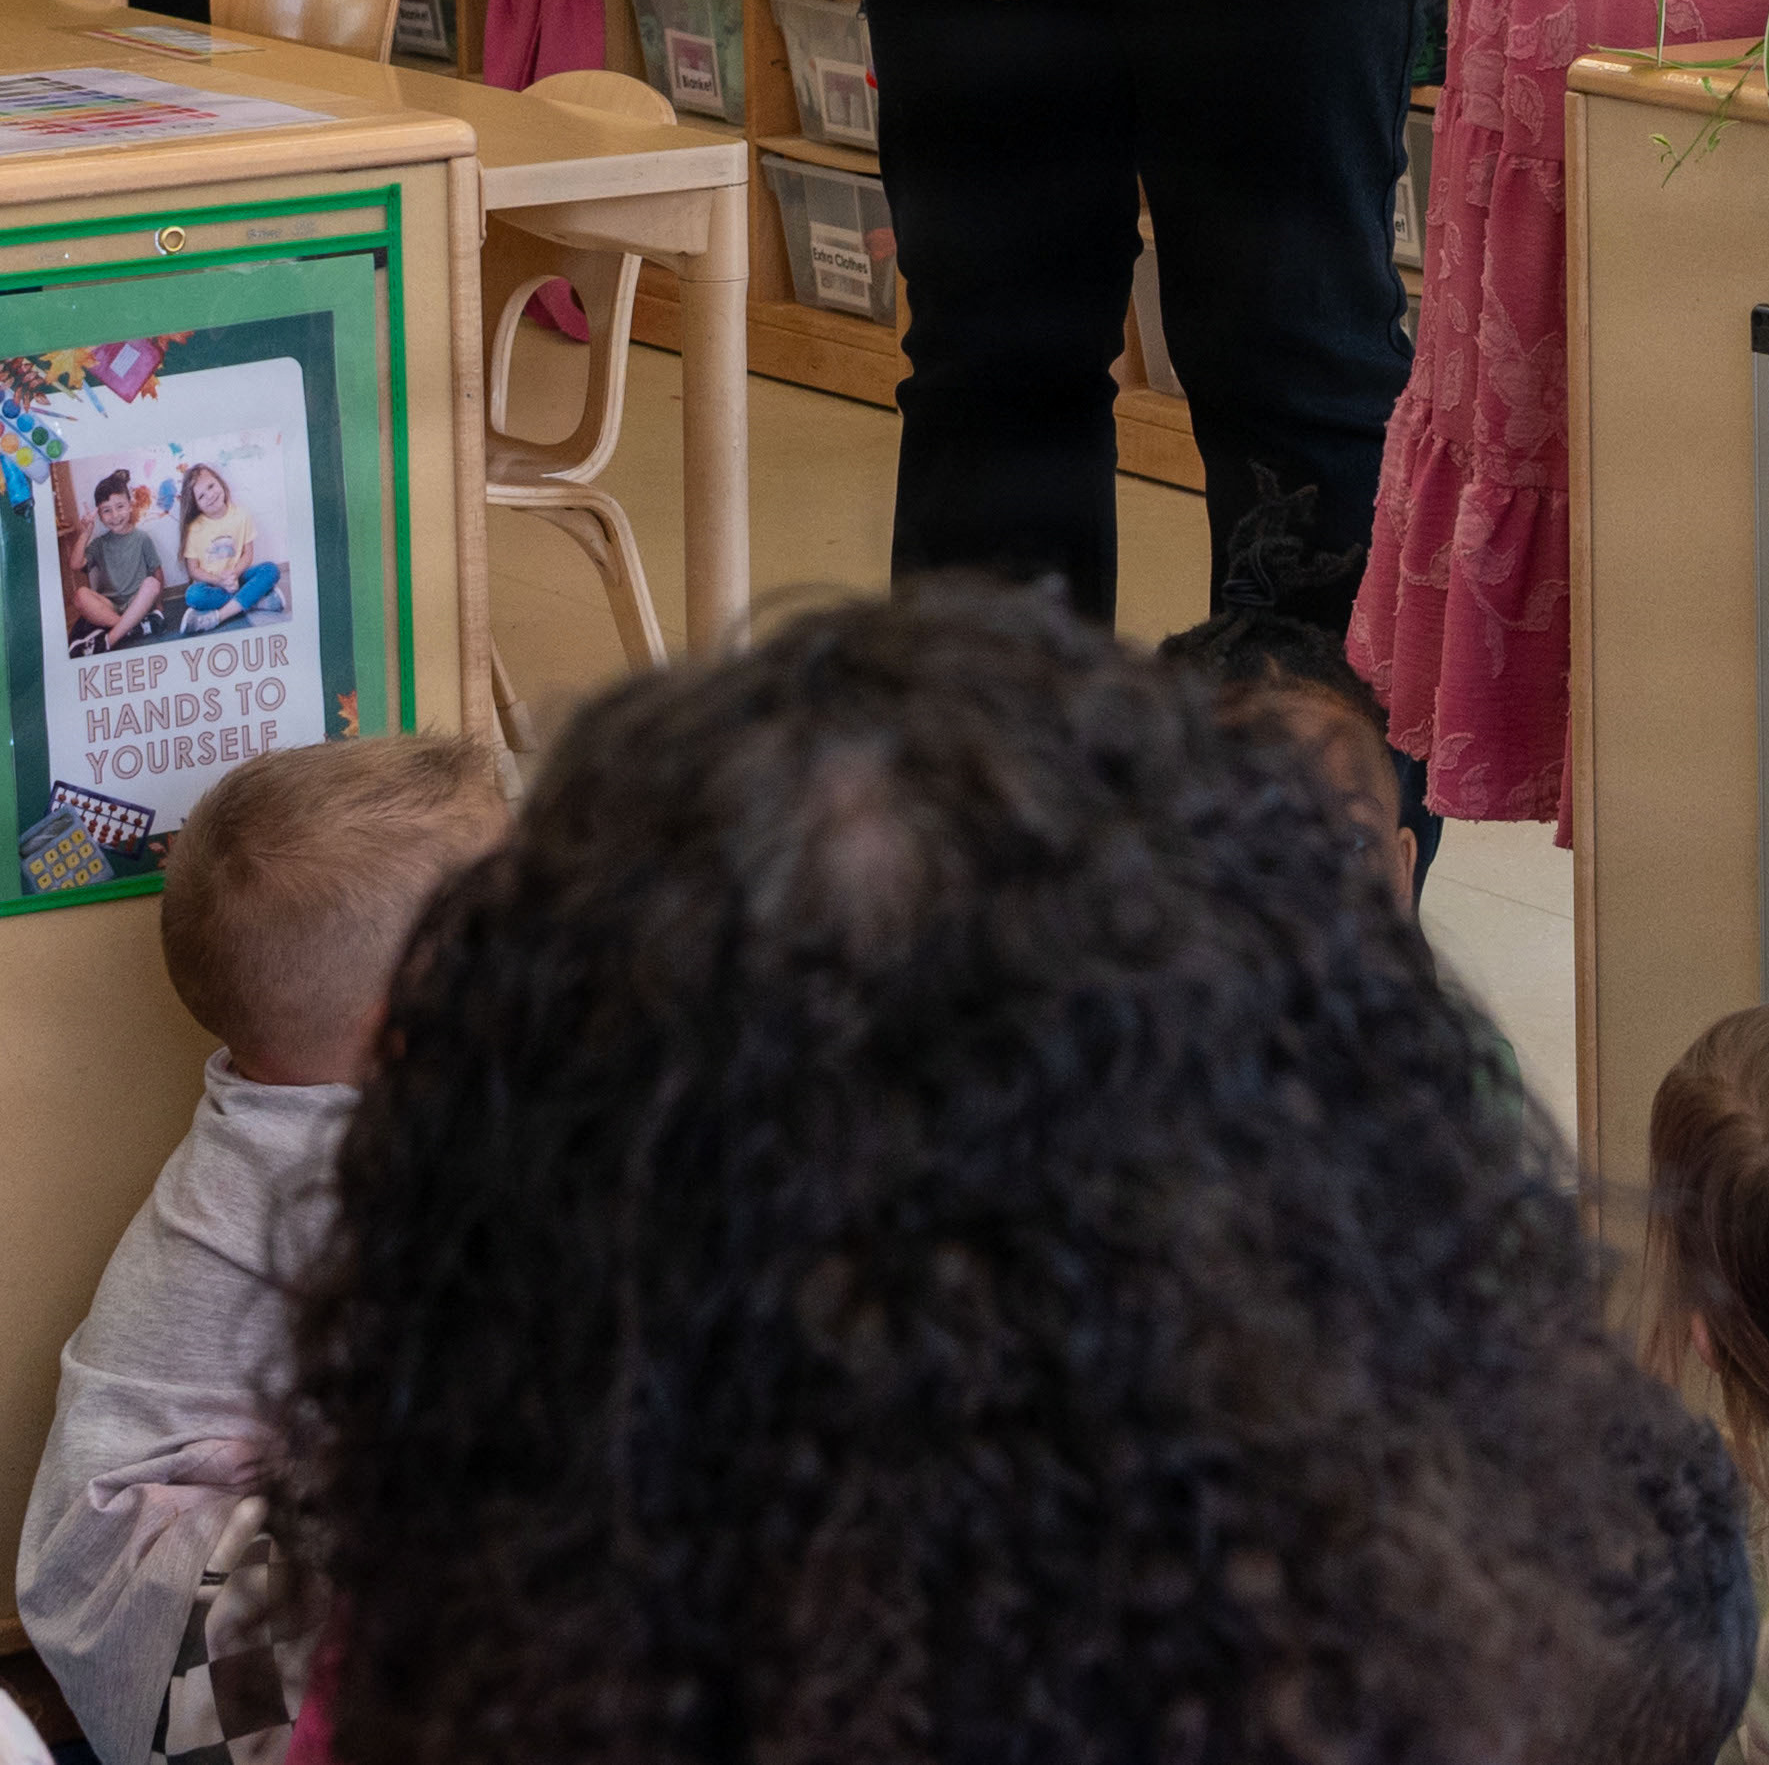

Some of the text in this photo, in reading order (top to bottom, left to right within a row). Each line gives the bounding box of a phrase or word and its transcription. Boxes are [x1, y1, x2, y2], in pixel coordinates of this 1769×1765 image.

[682, 75, 713, 93] Blanket
[812, 246, 869, 276] Extra Clothes
[77, 633, 289, 702] KEEP YOUR
[86, 677, 287, 744] HANDS TO
[87, 719, 279, 784] YOURSELF
